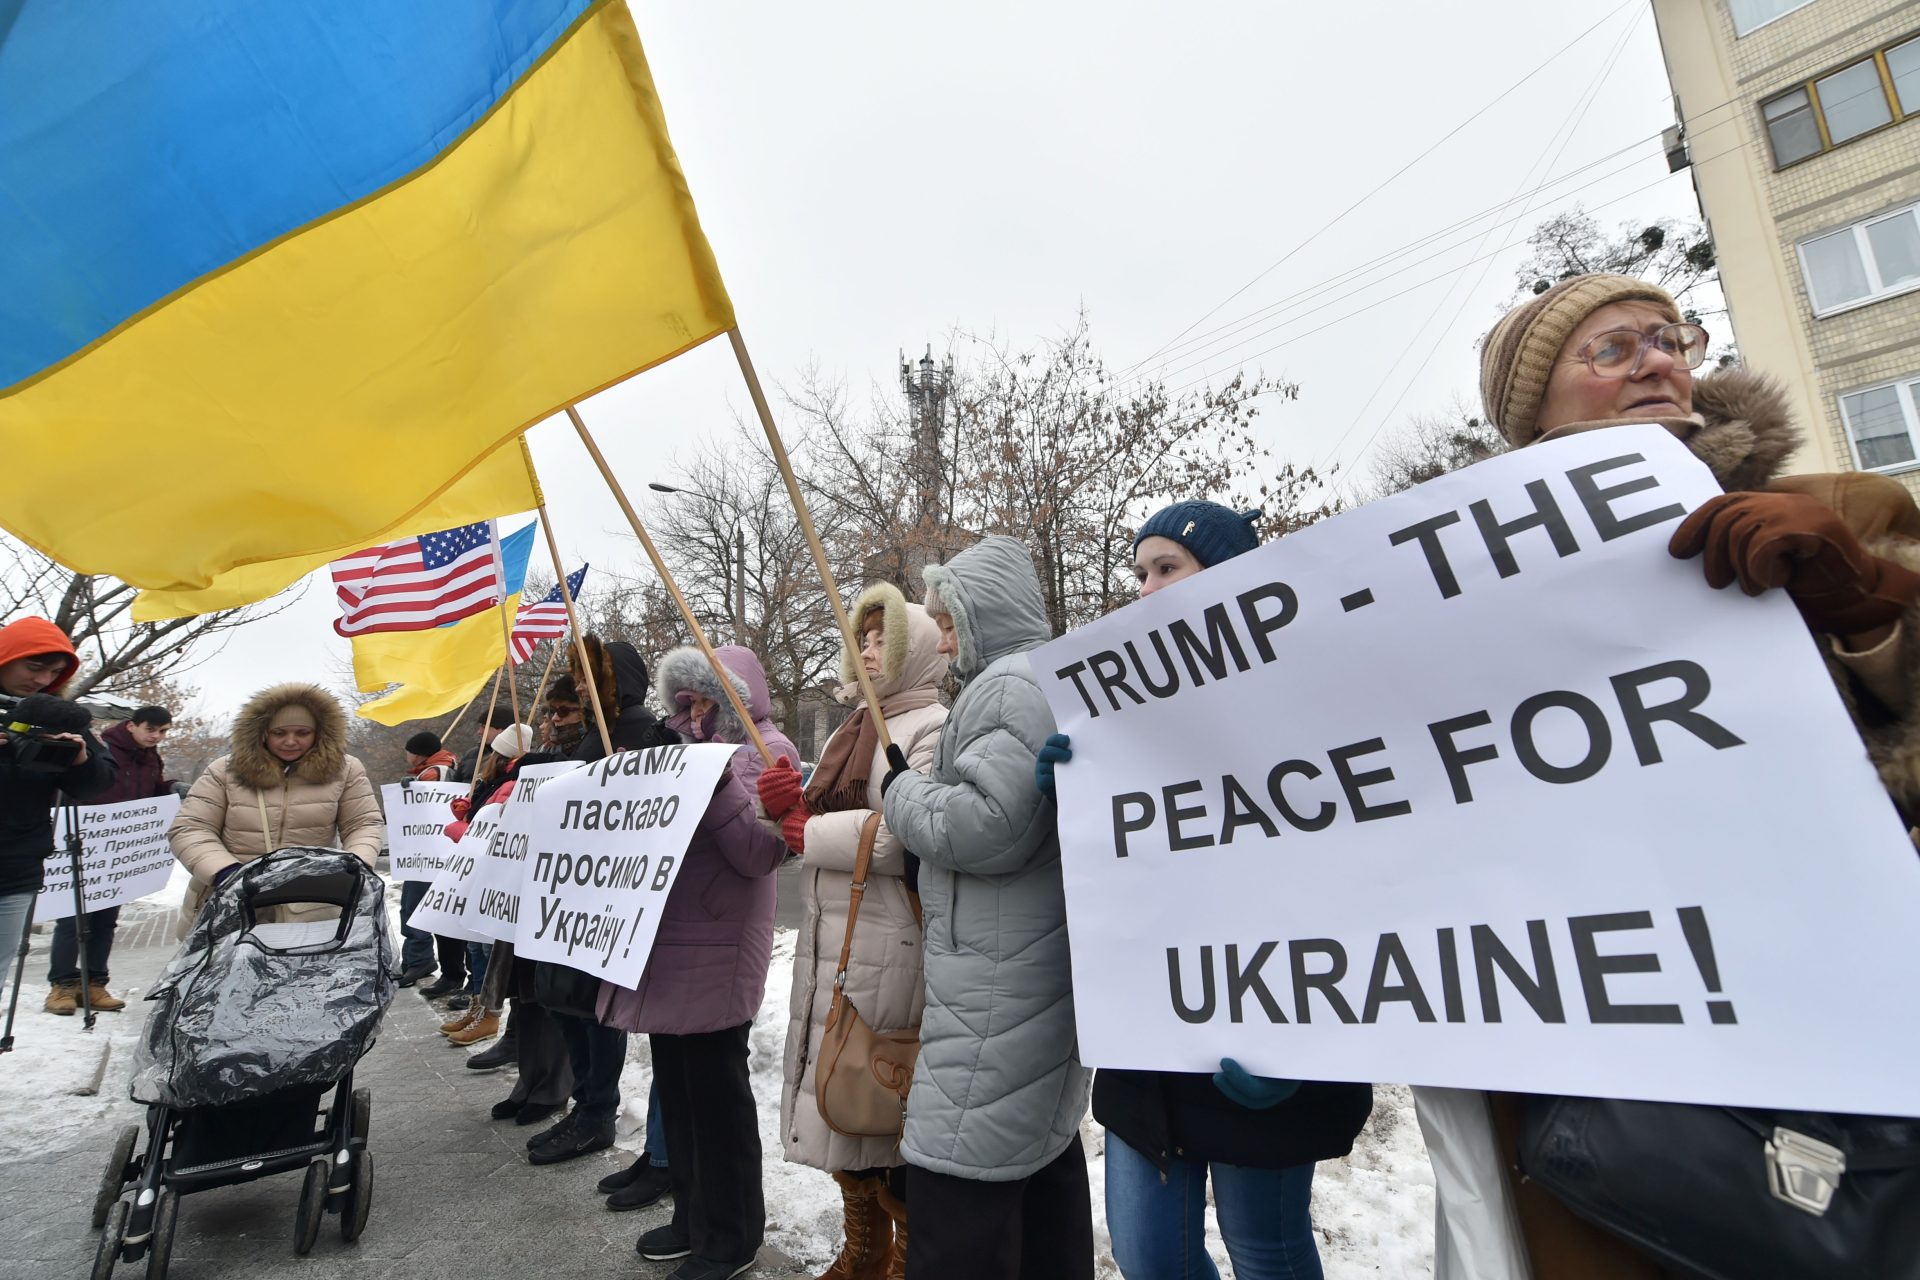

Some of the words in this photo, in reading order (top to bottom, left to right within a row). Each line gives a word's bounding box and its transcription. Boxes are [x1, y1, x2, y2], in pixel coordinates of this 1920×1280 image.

[1055, 581, 1299, 719] TRUMP
[1340, 587, 1375, 613] -
[1389, 452, 1688, 600] THE
[1111, 736, 1413, 859] PEACE
[1428, 659, 1747, 805] FOR
[82, 811, 107, 824] Не
[111, 805, 158, 822] можна
[560, 794, 681, 831] ласкаво
[104, 832, 168, 853] Принайм
[402, 823, 444, 837] психол
[107, 858, 175, 883] тривалого
[111, 847, 161, 869] робити
[396, 852, 445, 872] майбутнь
[533, 852, 649, 894] просимо
[420, 887, 467, 916] раїн
[479, 888, 521, 924] UKRAI
[1165, 906, 1739, 1026] UKRAINE!
